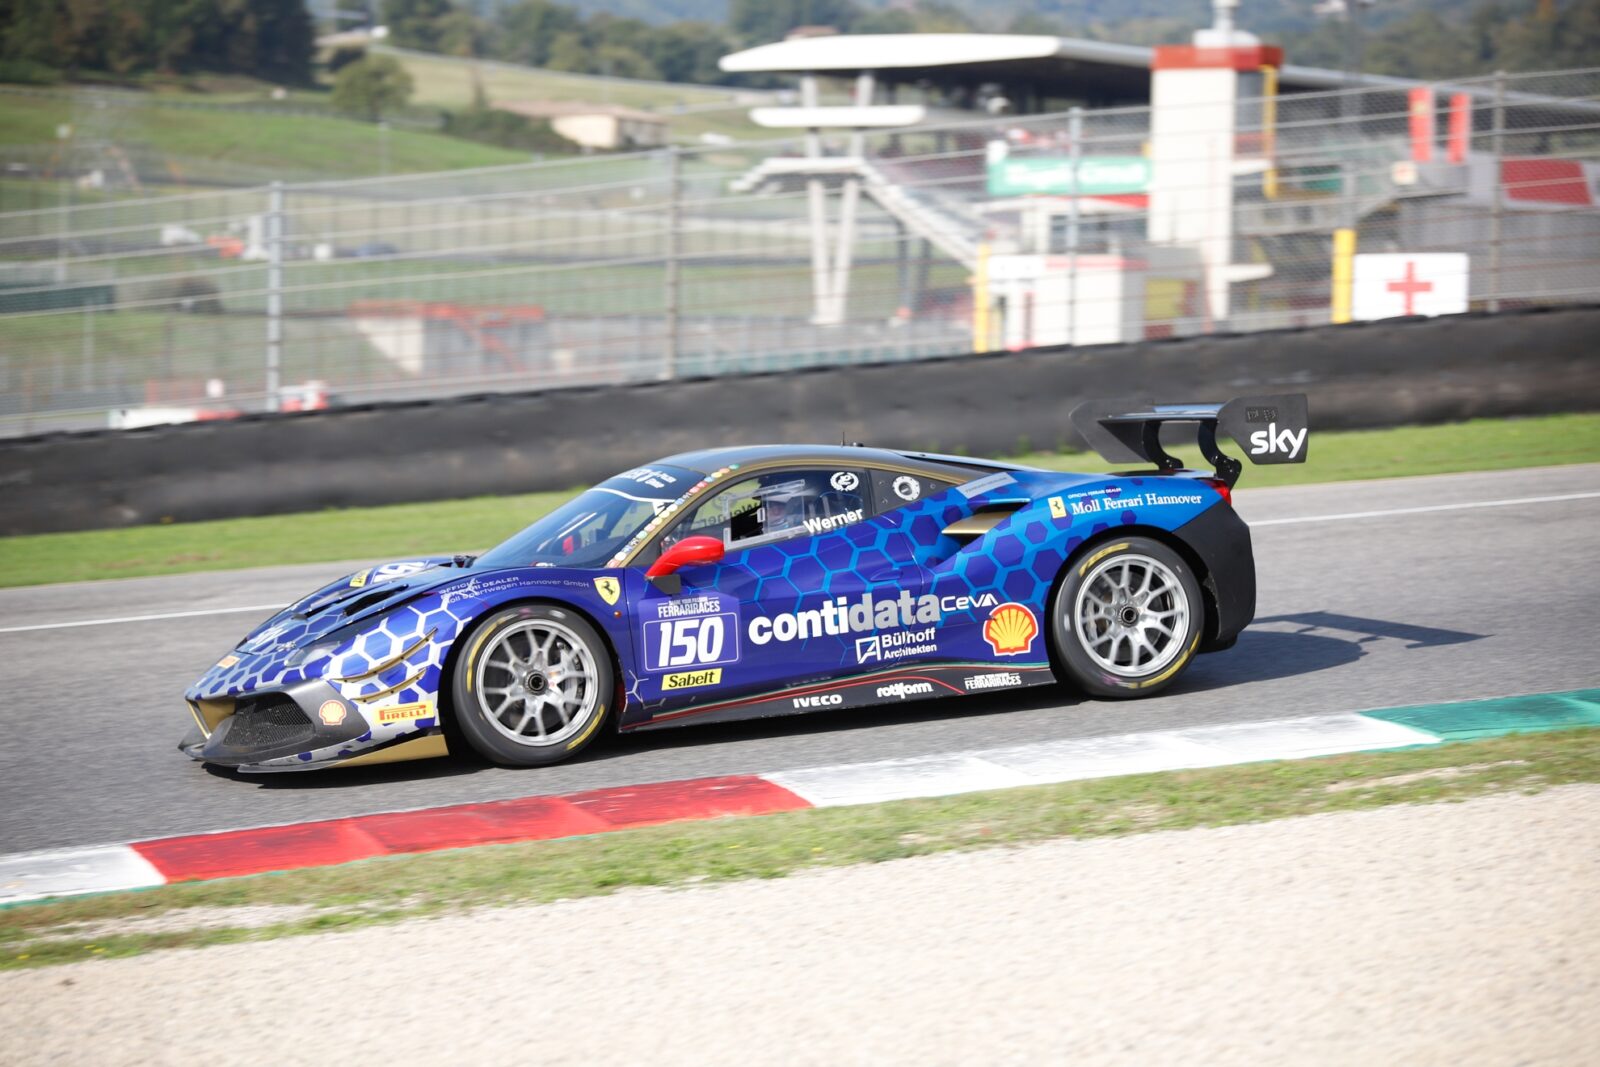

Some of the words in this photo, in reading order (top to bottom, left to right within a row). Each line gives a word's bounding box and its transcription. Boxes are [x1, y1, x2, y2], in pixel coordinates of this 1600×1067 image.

[1250, 422, 1308, 459] sky
[1071, 501, 1101, 515] Moll
[1104, 494, 1144, 510] Ferrari
[1145, 493, 1202, 506] Hannover
[803, 507, 863, 534] Werner
[482, 576, 520, 588] DEALER
[563, 580, 590, 588] GmbH
[748, 589, 942, 645] contidata
[658, 616, 724, 667] 150
[883, 644, 937, 660] Architekten
[668, 670, 715, 688] Sabelt
[792, 694, 843, 709] IVECO
[379, 704, 427, 720] PIRELLI
